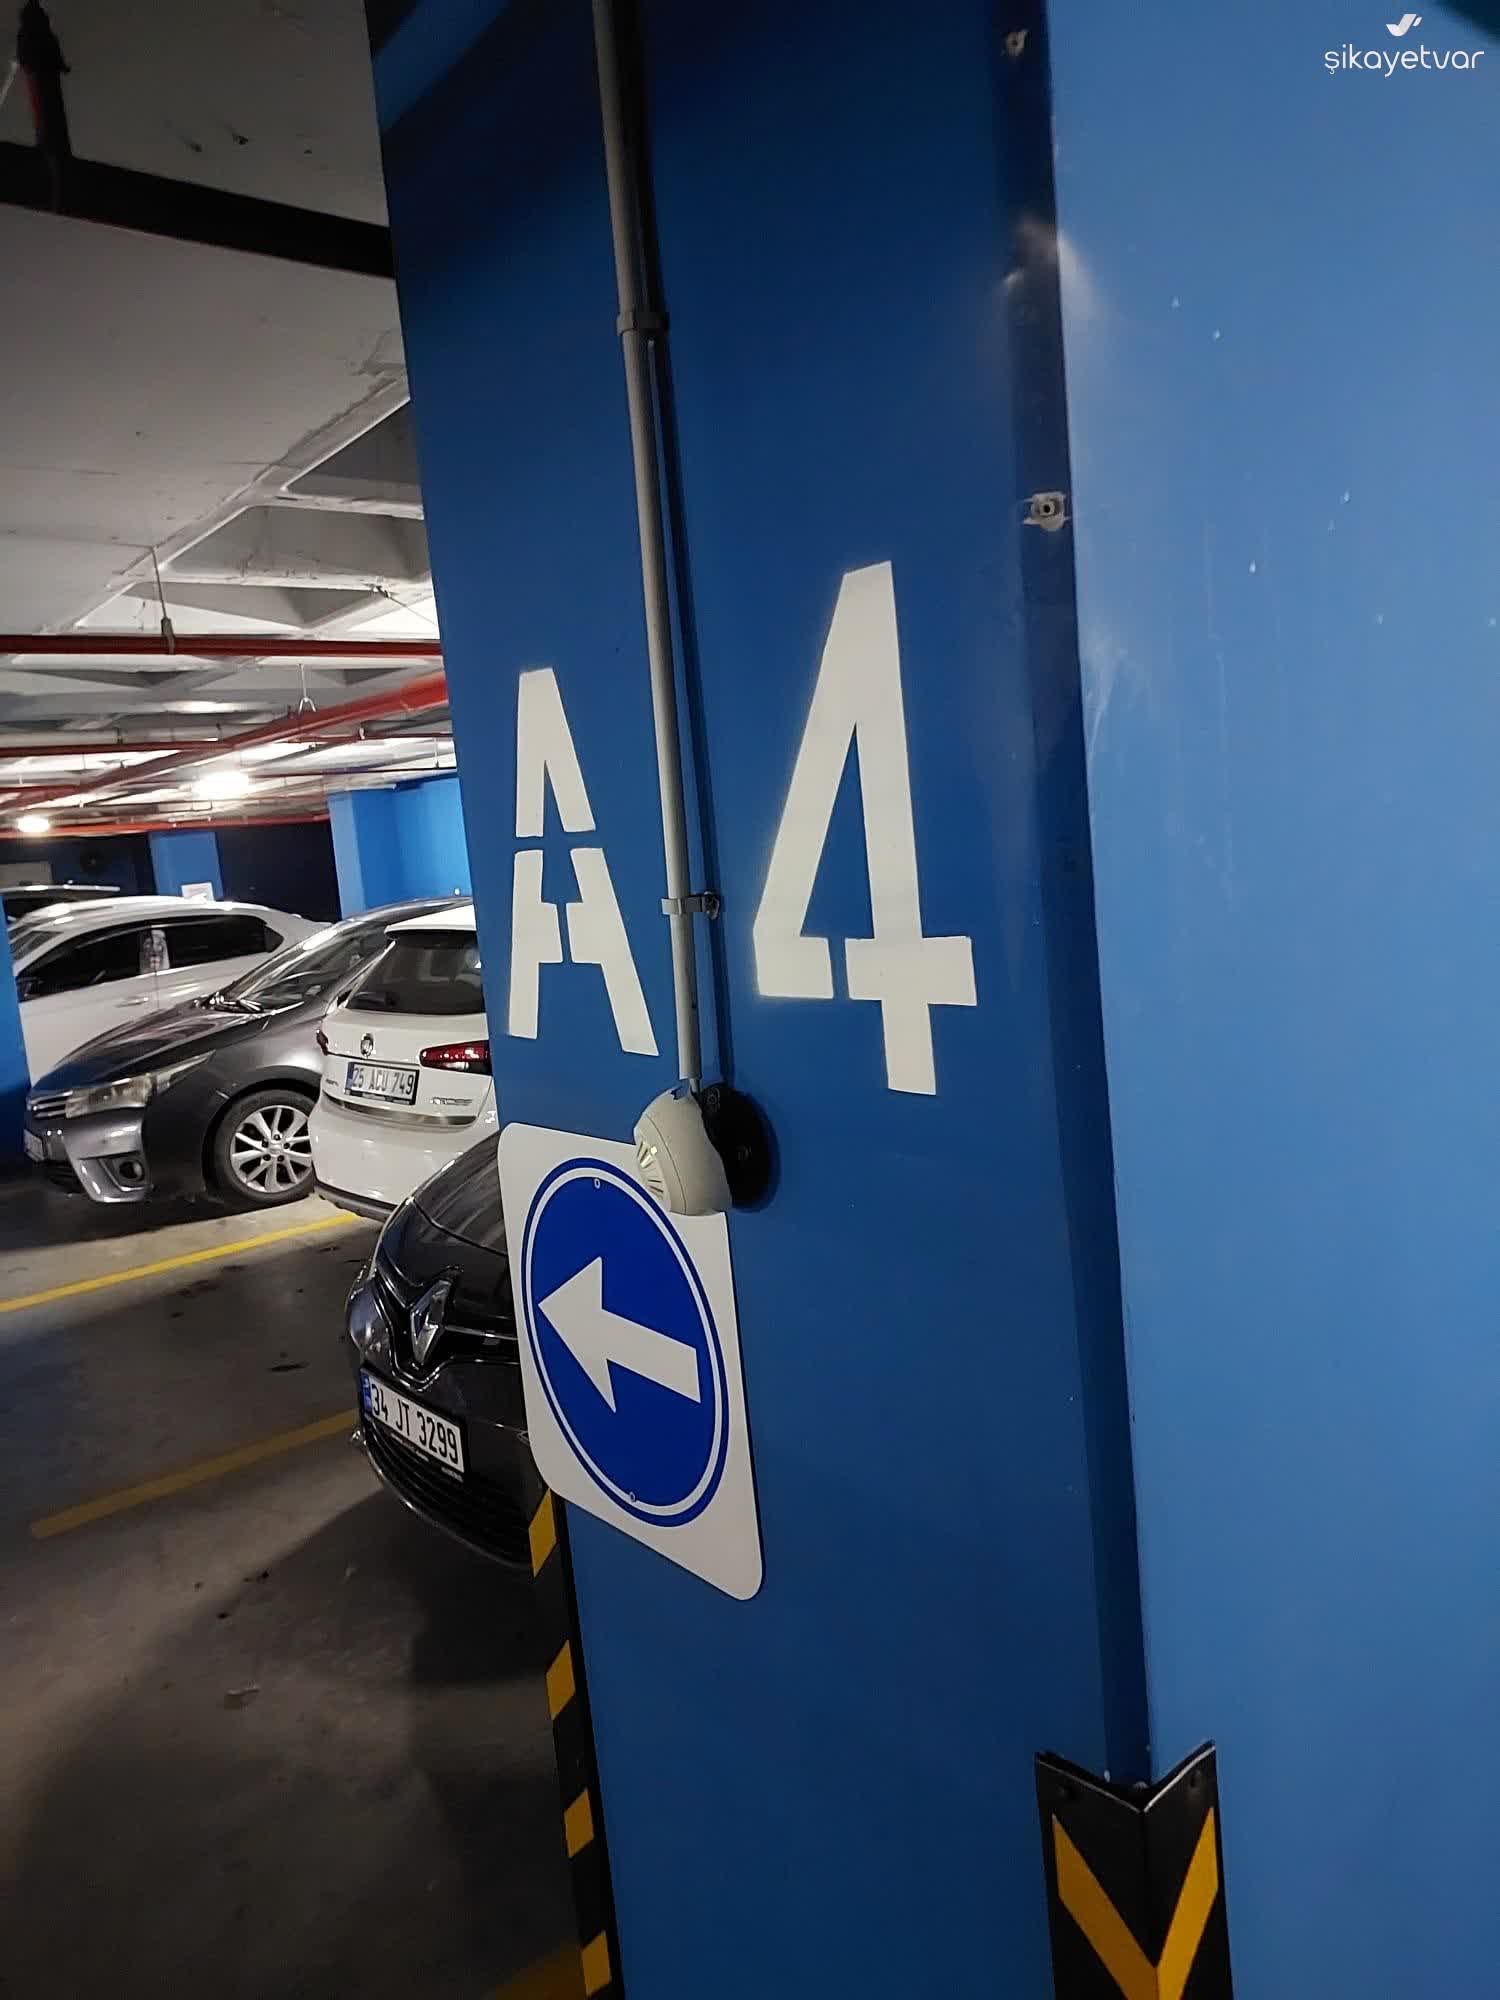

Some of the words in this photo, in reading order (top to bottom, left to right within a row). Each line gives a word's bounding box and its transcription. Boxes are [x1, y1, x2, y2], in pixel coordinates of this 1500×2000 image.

[508, 667, 660, 1057] A
[753, 559, 978, 1096] 4
[352, 1067, 364, 1089] 25
[392, 1071, 414, 1096] 749
[371, 1383, 389, 1422] 34
[396, 1399, 410, 1437] JT
[417, 1410, 459, 1465] 3299
